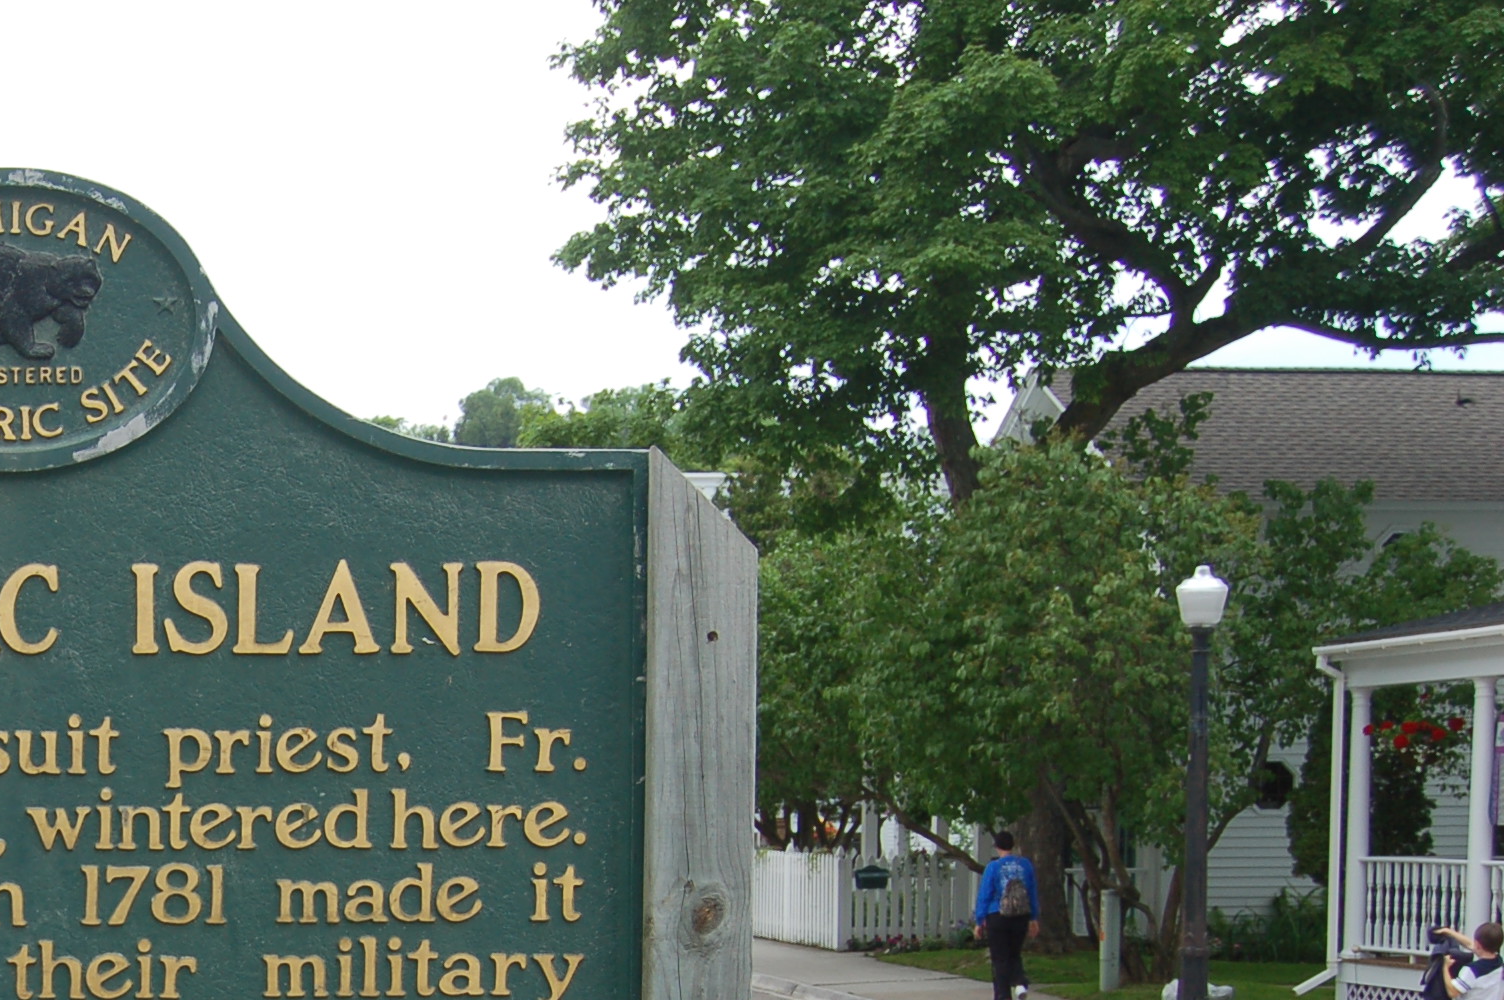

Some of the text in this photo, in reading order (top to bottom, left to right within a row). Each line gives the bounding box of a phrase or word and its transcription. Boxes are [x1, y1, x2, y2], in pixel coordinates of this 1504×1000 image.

[79, 339, 173, 425] SITE
[131, 559, 541, 656] ISLAND
[163, 713, 412, 789] priest,
[486, 711, 587, 772] Fr.
[26, 788, 373, 851] wintered
[390, 788, 587, 850] here.
[81, 862, 226, 926] 1781
[276, 862, 484, 924] made
[531, 861, 585, 922] it
[7, 938, 198, 1000] their
